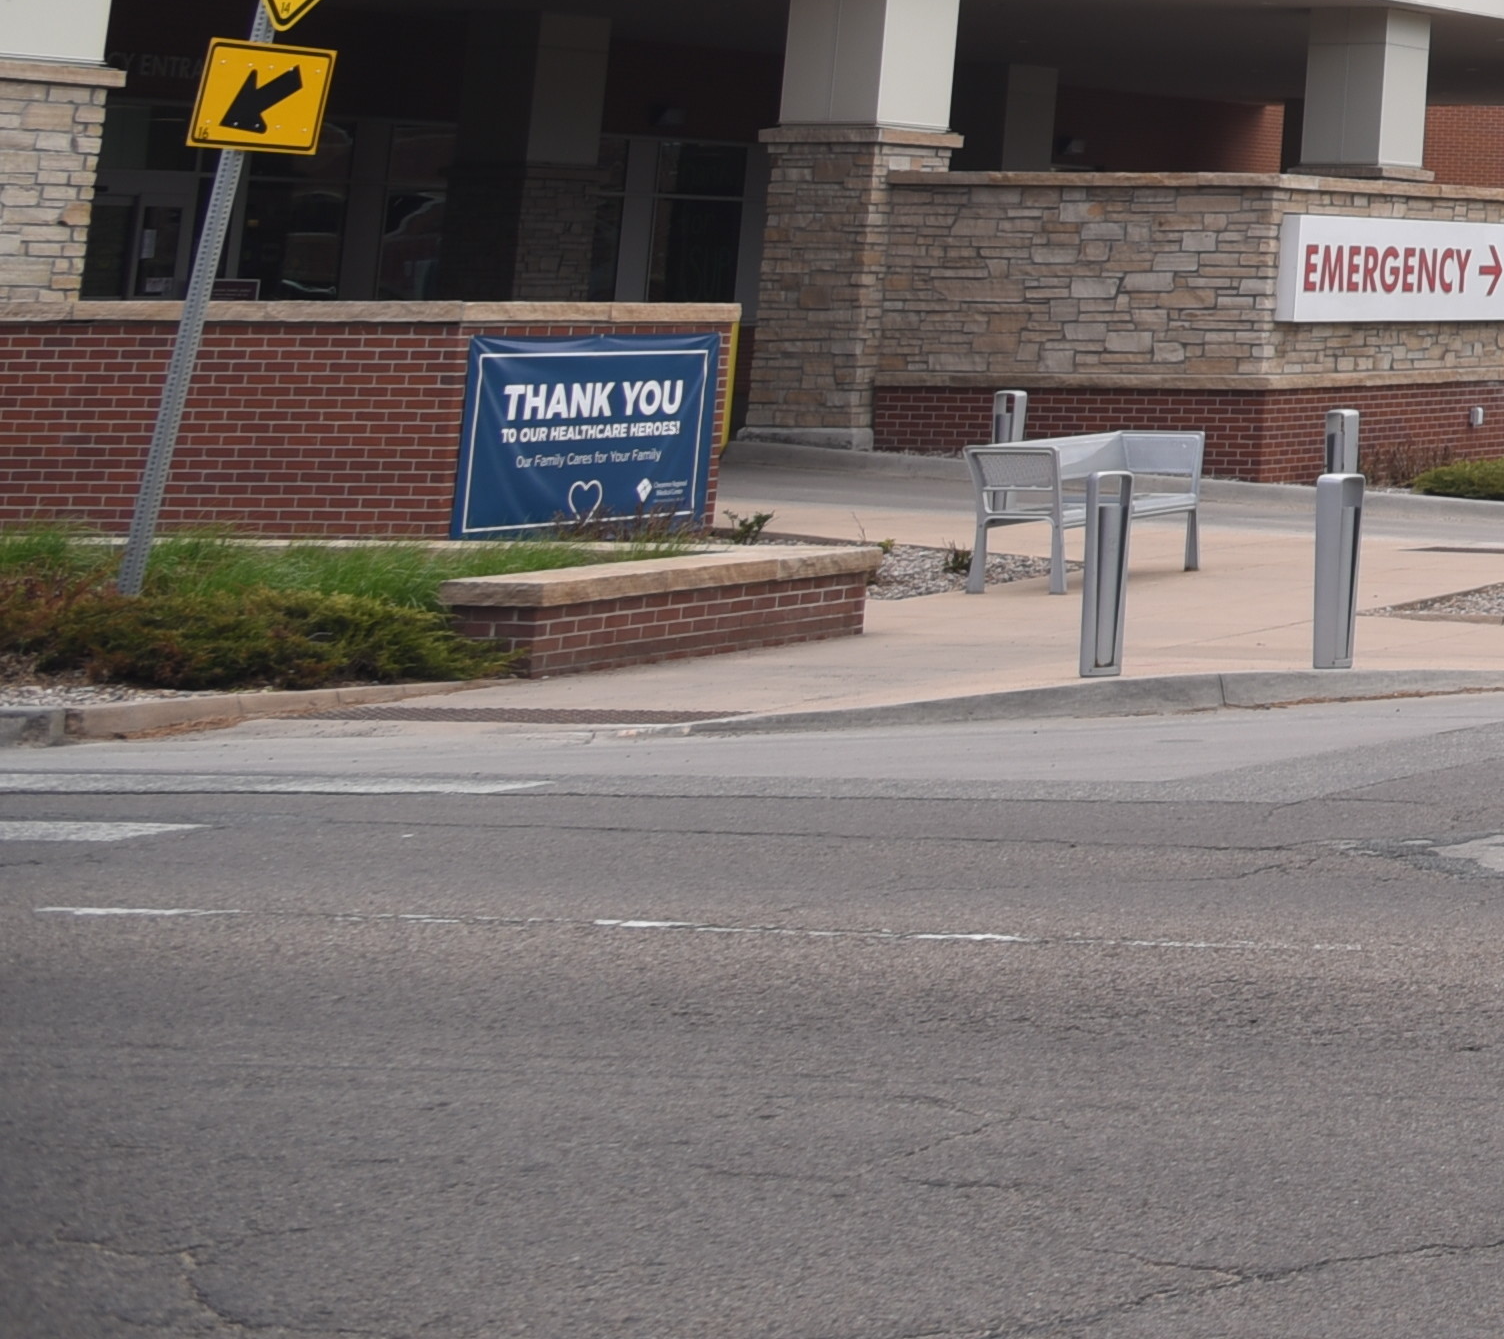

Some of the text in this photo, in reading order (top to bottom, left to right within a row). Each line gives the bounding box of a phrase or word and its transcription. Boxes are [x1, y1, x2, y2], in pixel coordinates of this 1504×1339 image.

[1302, 243, 1472, 295] EMERGENCY
[504, 379, 684, 421] THANK YOU
[501, 421, 680, 443] TO OUR HEALTHCARE HEROES!
[516, 447, 662, 468] Our Family Cares for Your Family
